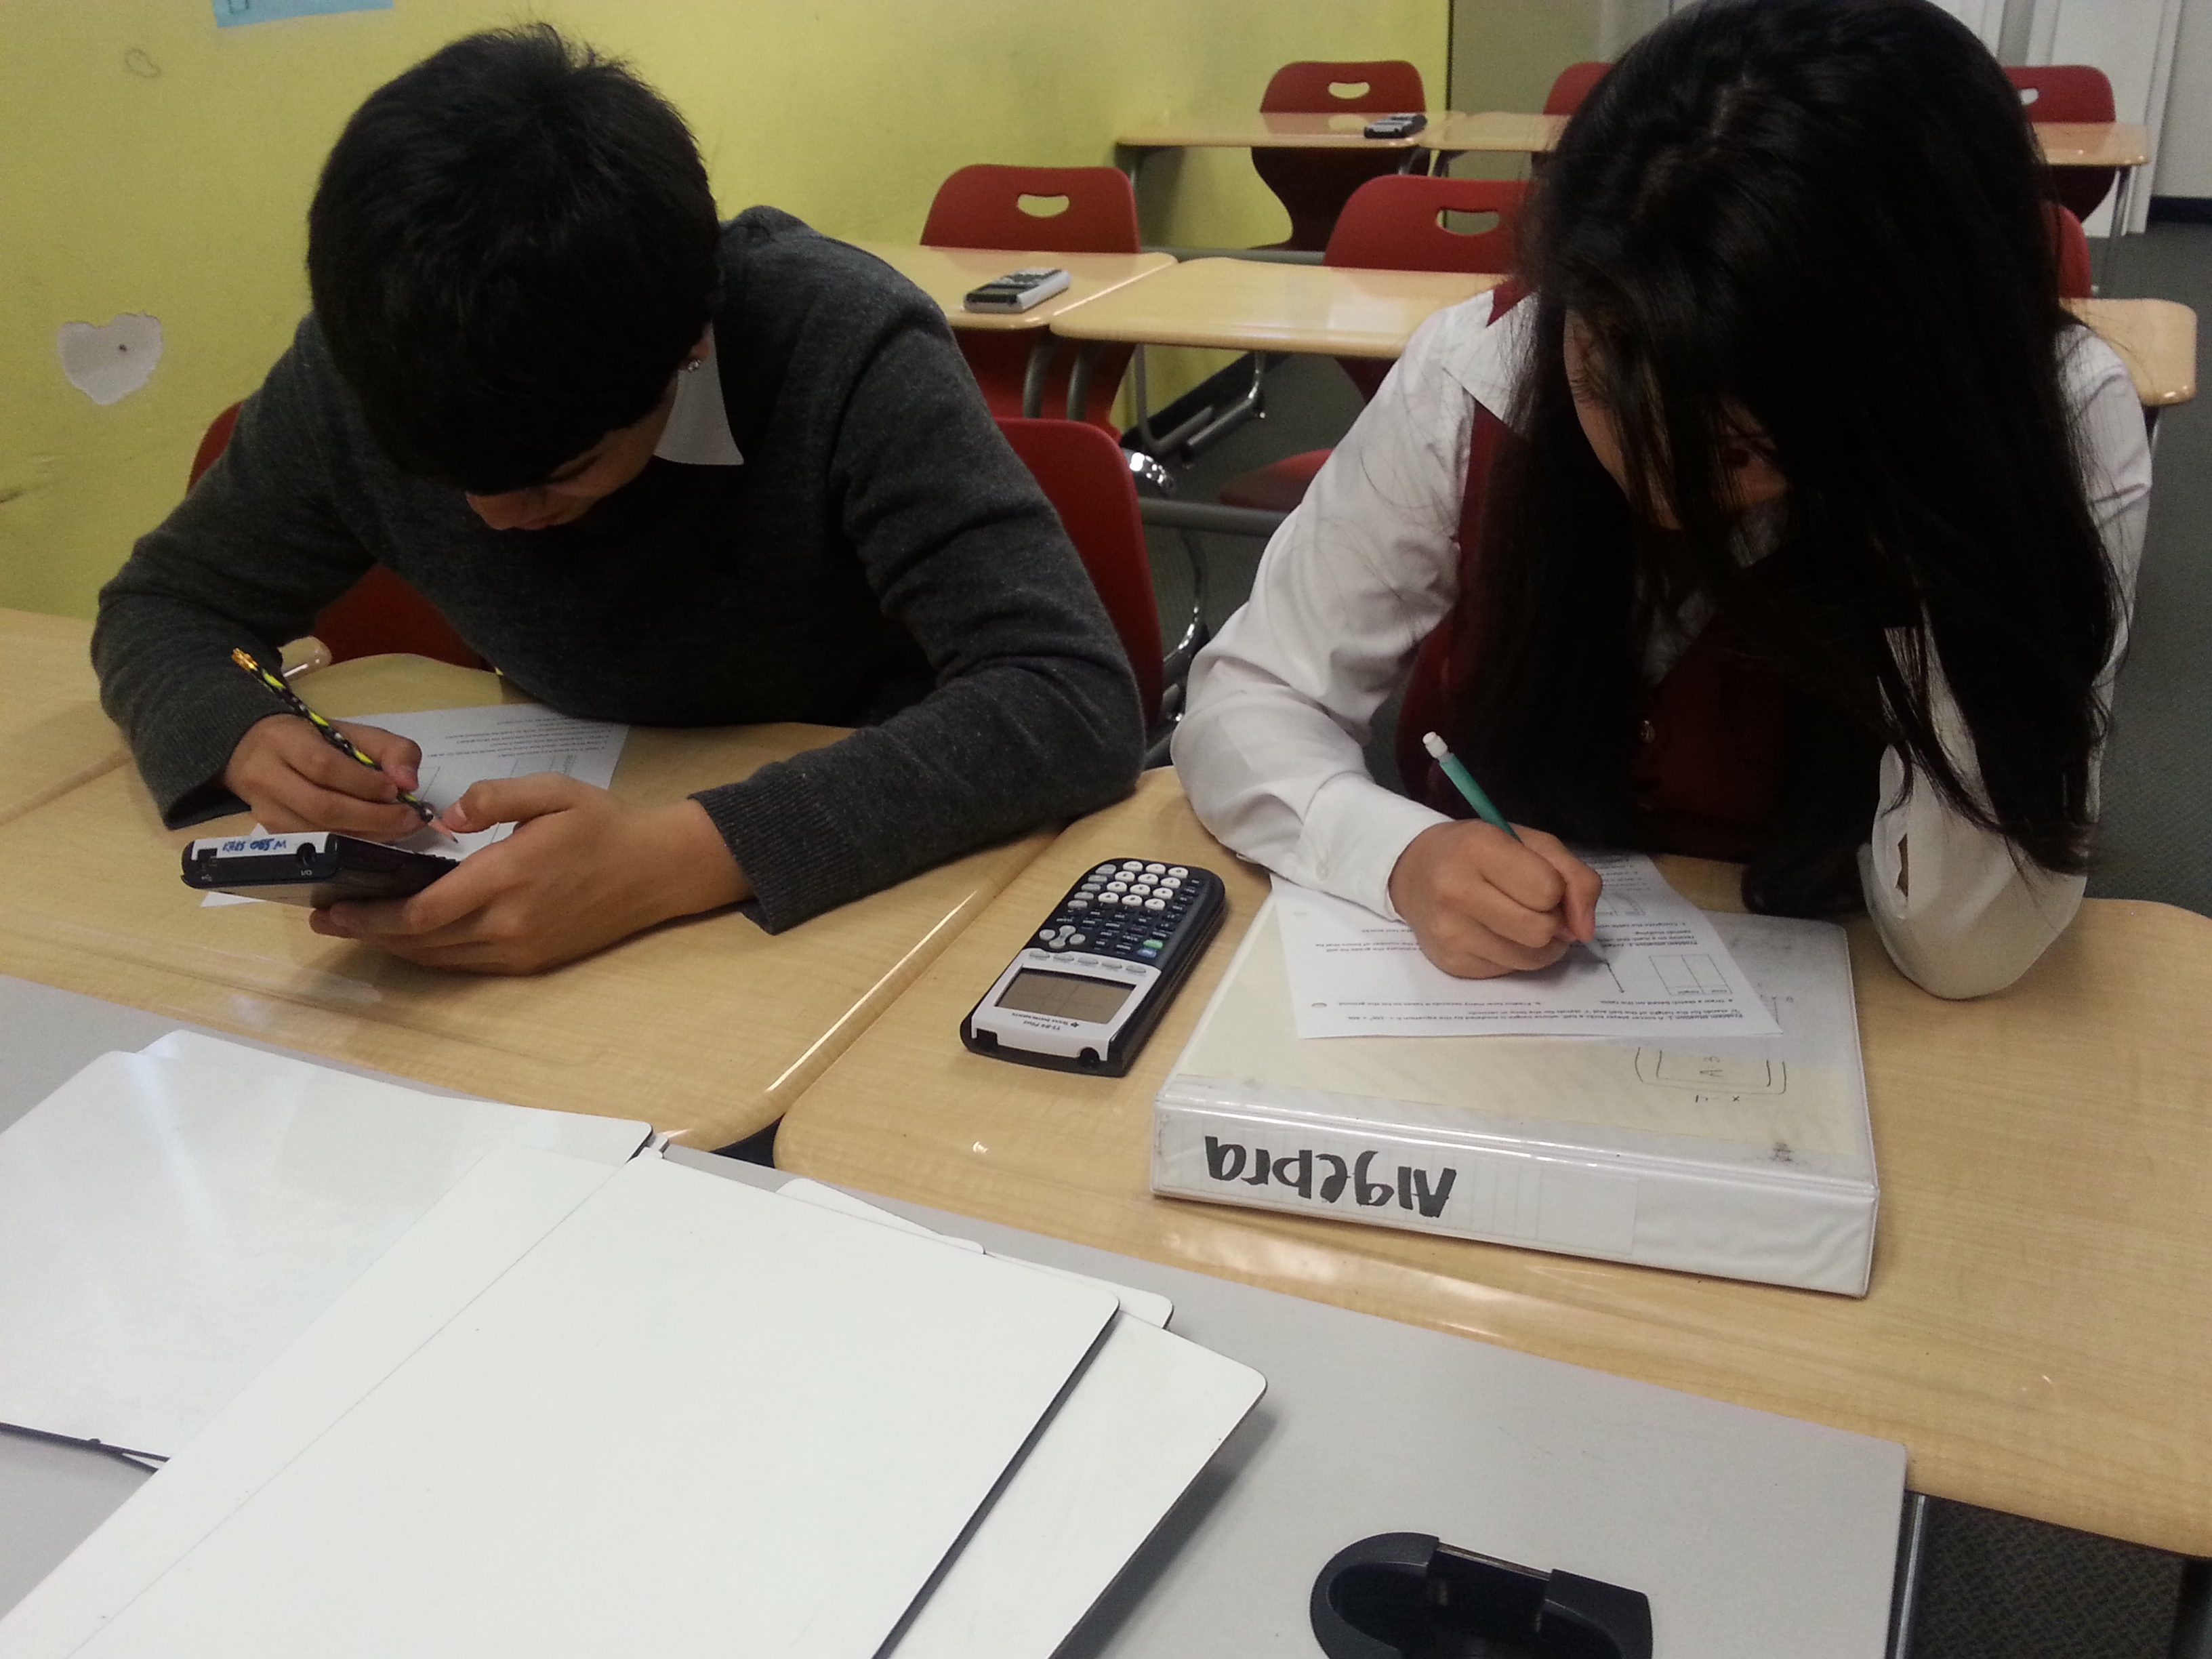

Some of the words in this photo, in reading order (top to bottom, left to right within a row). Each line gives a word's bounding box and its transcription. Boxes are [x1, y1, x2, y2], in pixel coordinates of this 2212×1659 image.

[1011, 1012, 1050, 1023] INSTRUMENTS
[1023, 1020, 1040, 1029] Plus
[1041, 1023, 1061, 1031] TI-84
[1204, 1135, 1457, 1218] Algebra
